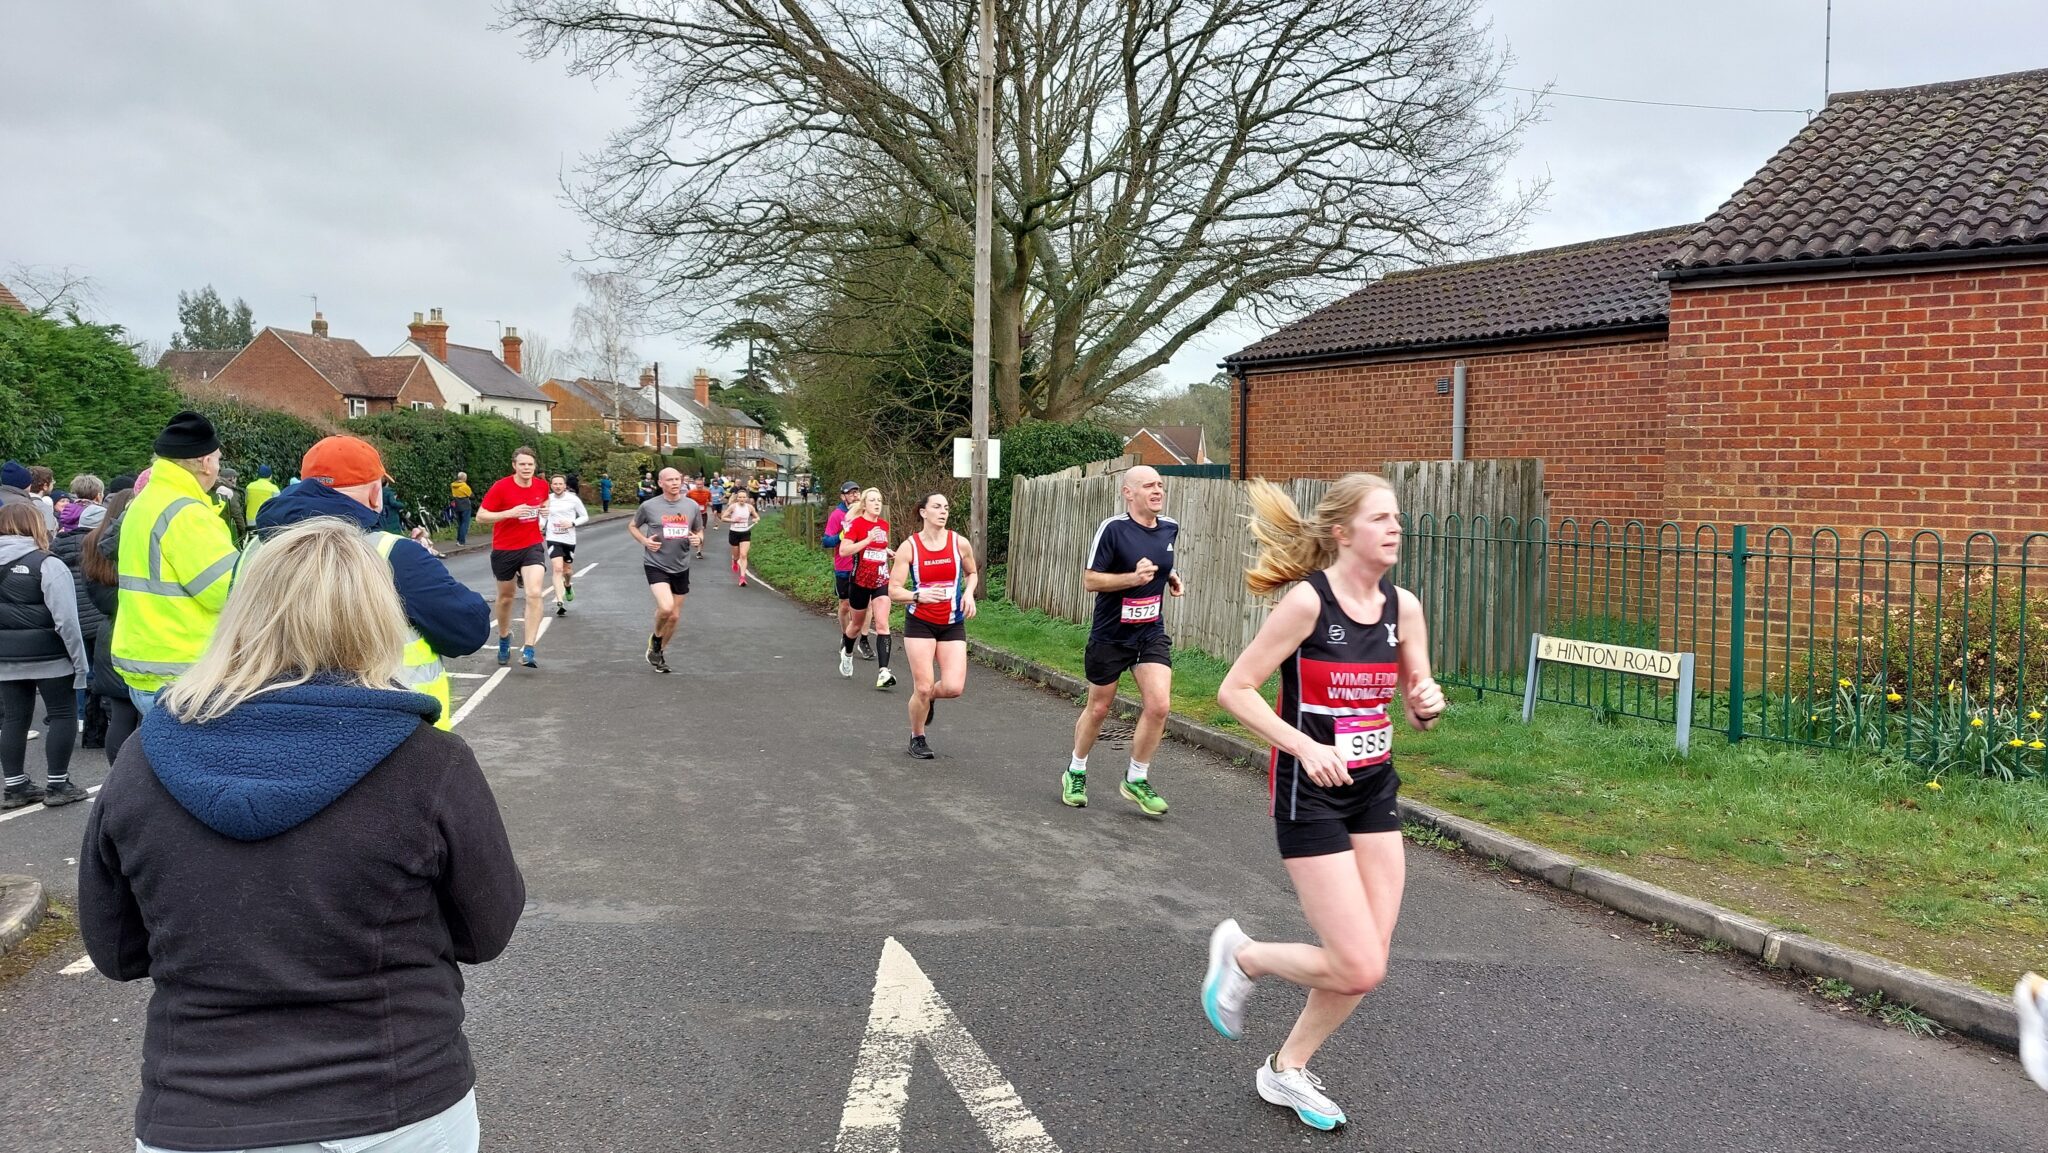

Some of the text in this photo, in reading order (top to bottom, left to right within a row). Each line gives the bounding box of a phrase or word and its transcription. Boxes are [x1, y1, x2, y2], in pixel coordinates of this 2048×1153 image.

[923, 558, 952, 566] READING
[1128, 605, 1156, 618] 1572
[1556, 642, 1672, 674] HINTON ROAD
[1352, 731, 1387, 756] 988
